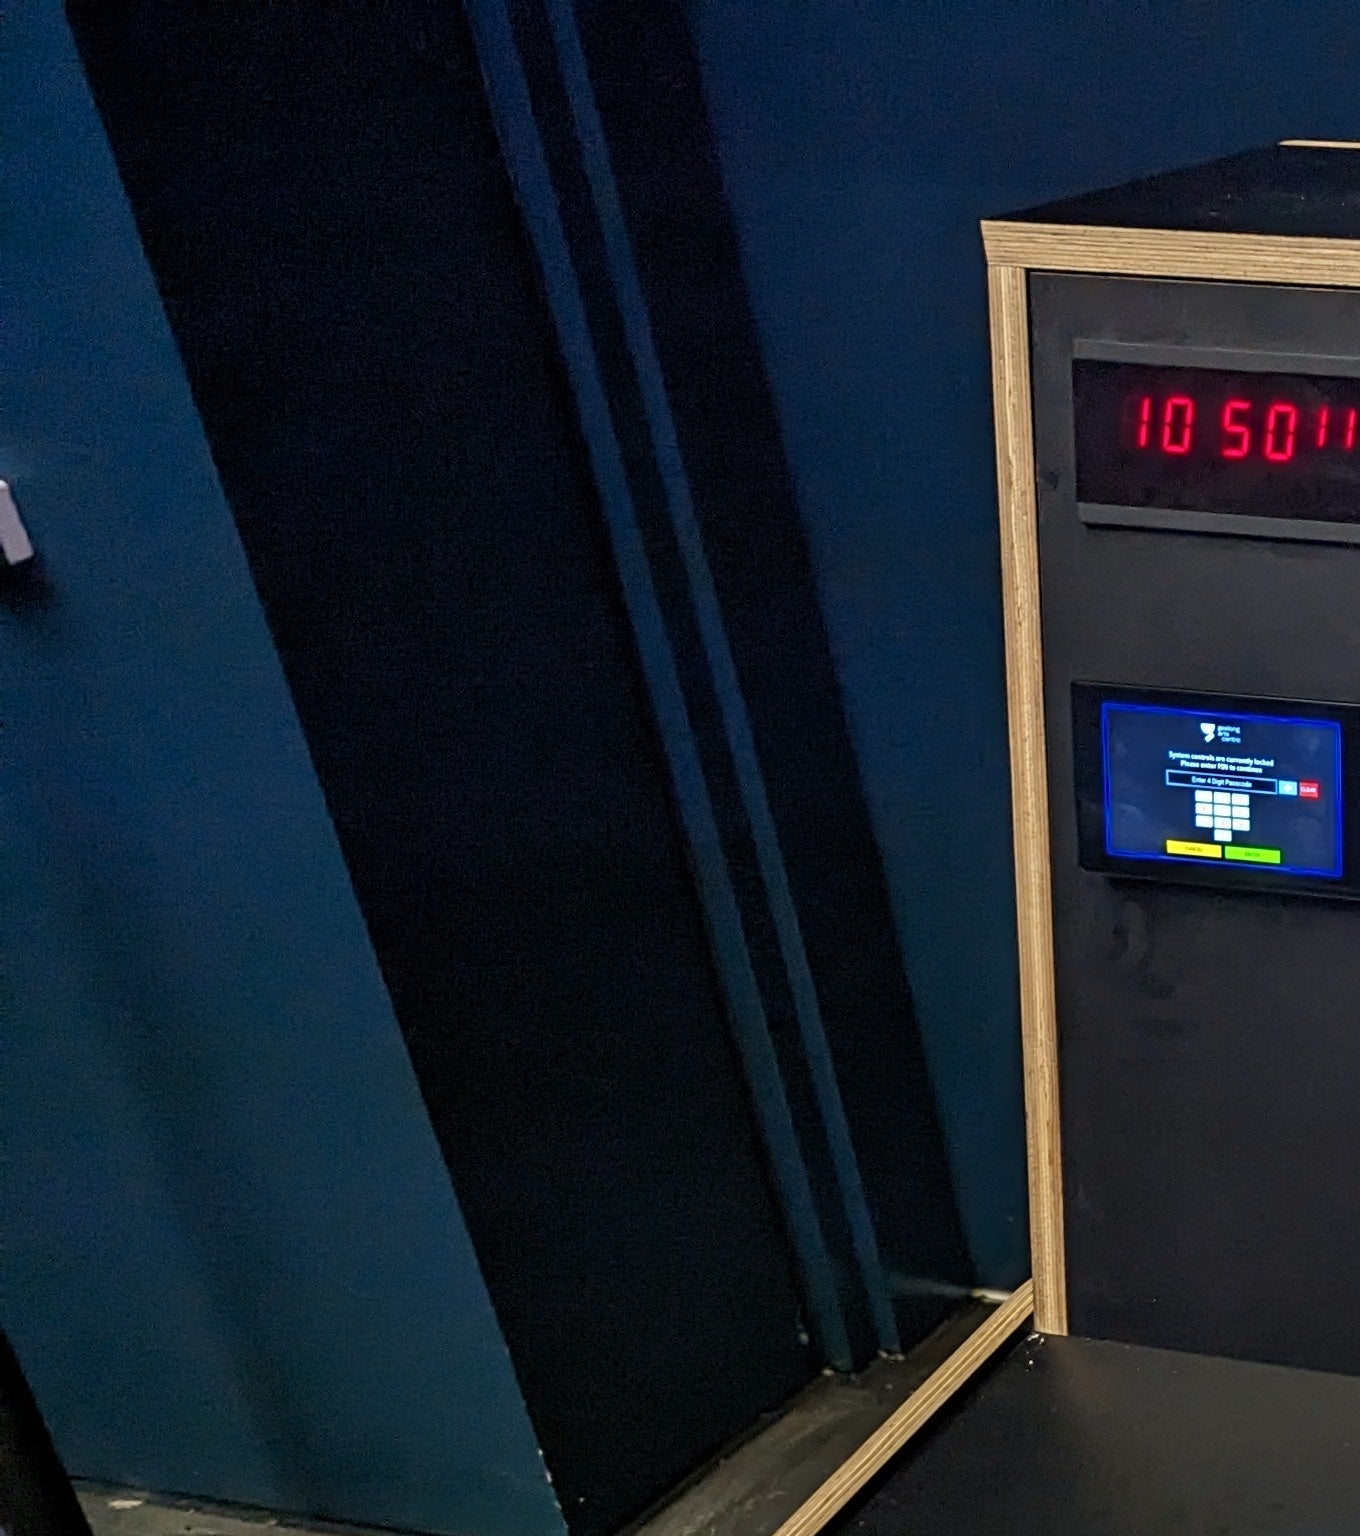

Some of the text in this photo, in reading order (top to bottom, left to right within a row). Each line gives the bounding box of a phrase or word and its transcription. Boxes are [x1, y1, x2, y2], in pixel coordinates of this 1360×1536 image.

[1137, 396, 1193, 453] 10
[1222, 401, 1296, 460] 50
[1168, 750, 1191, 760] System
[1254, 758, 1274, 767] locked
[1180, 760, 1200, 769] Please
[1191, 776, 1252, 788] Enter 4 Digit Passcode
